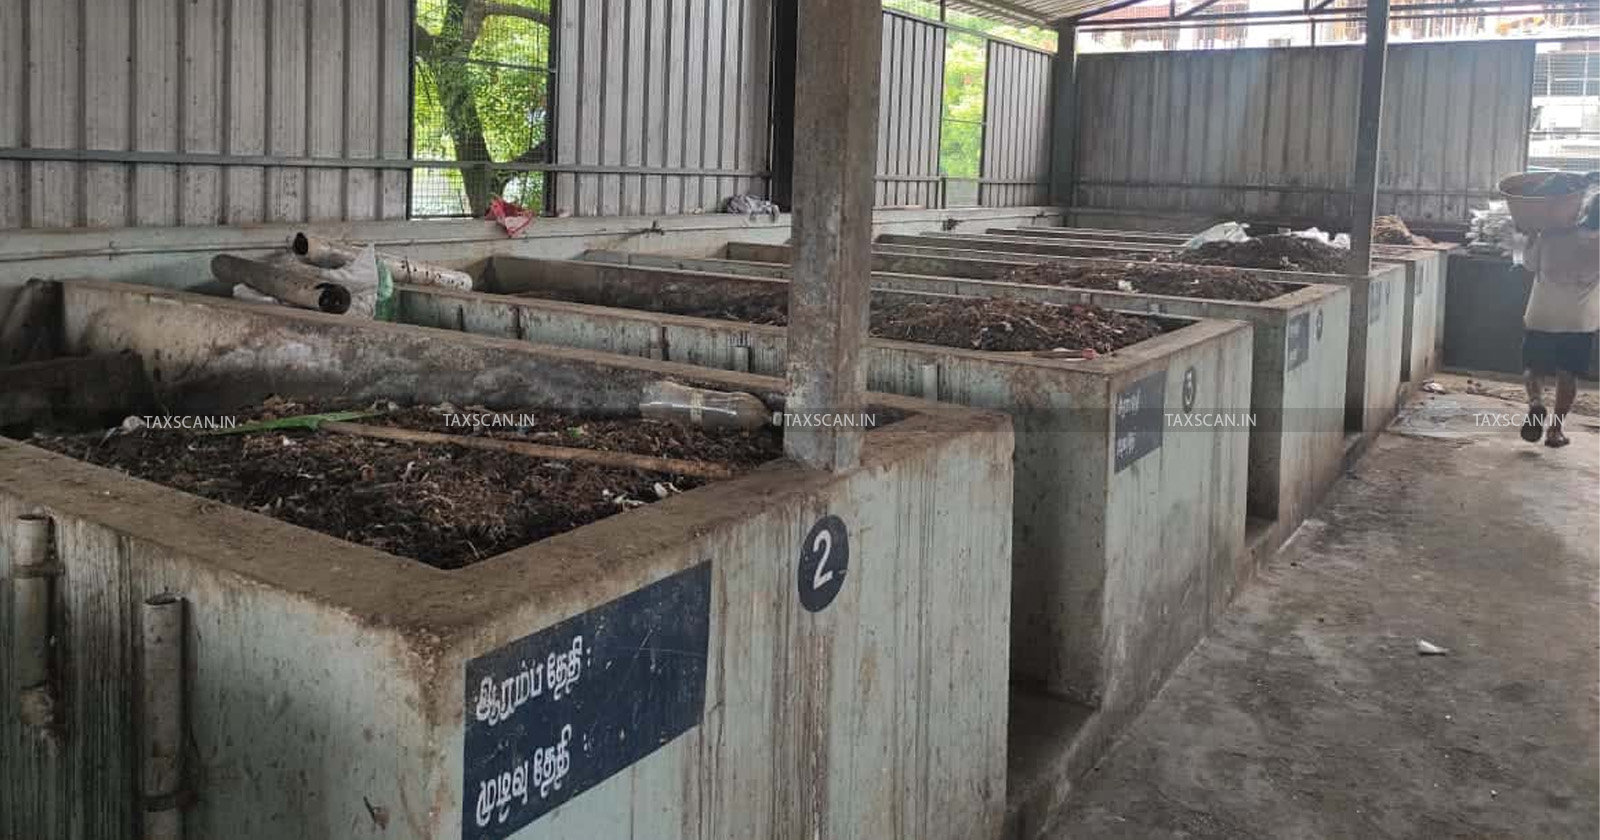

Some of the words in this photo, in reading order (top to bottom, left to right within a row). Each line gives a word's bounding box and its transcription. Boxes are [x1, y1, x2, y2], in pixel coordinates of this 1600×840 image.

[813, 529, 834, 590] 2
[475, 661, 544, 726] ஆரம்ப
[547, 635, 583, 701] தேதி
[476, 758, 529, 827] முடிவு
[533, 724, 572, 798] தேதி
